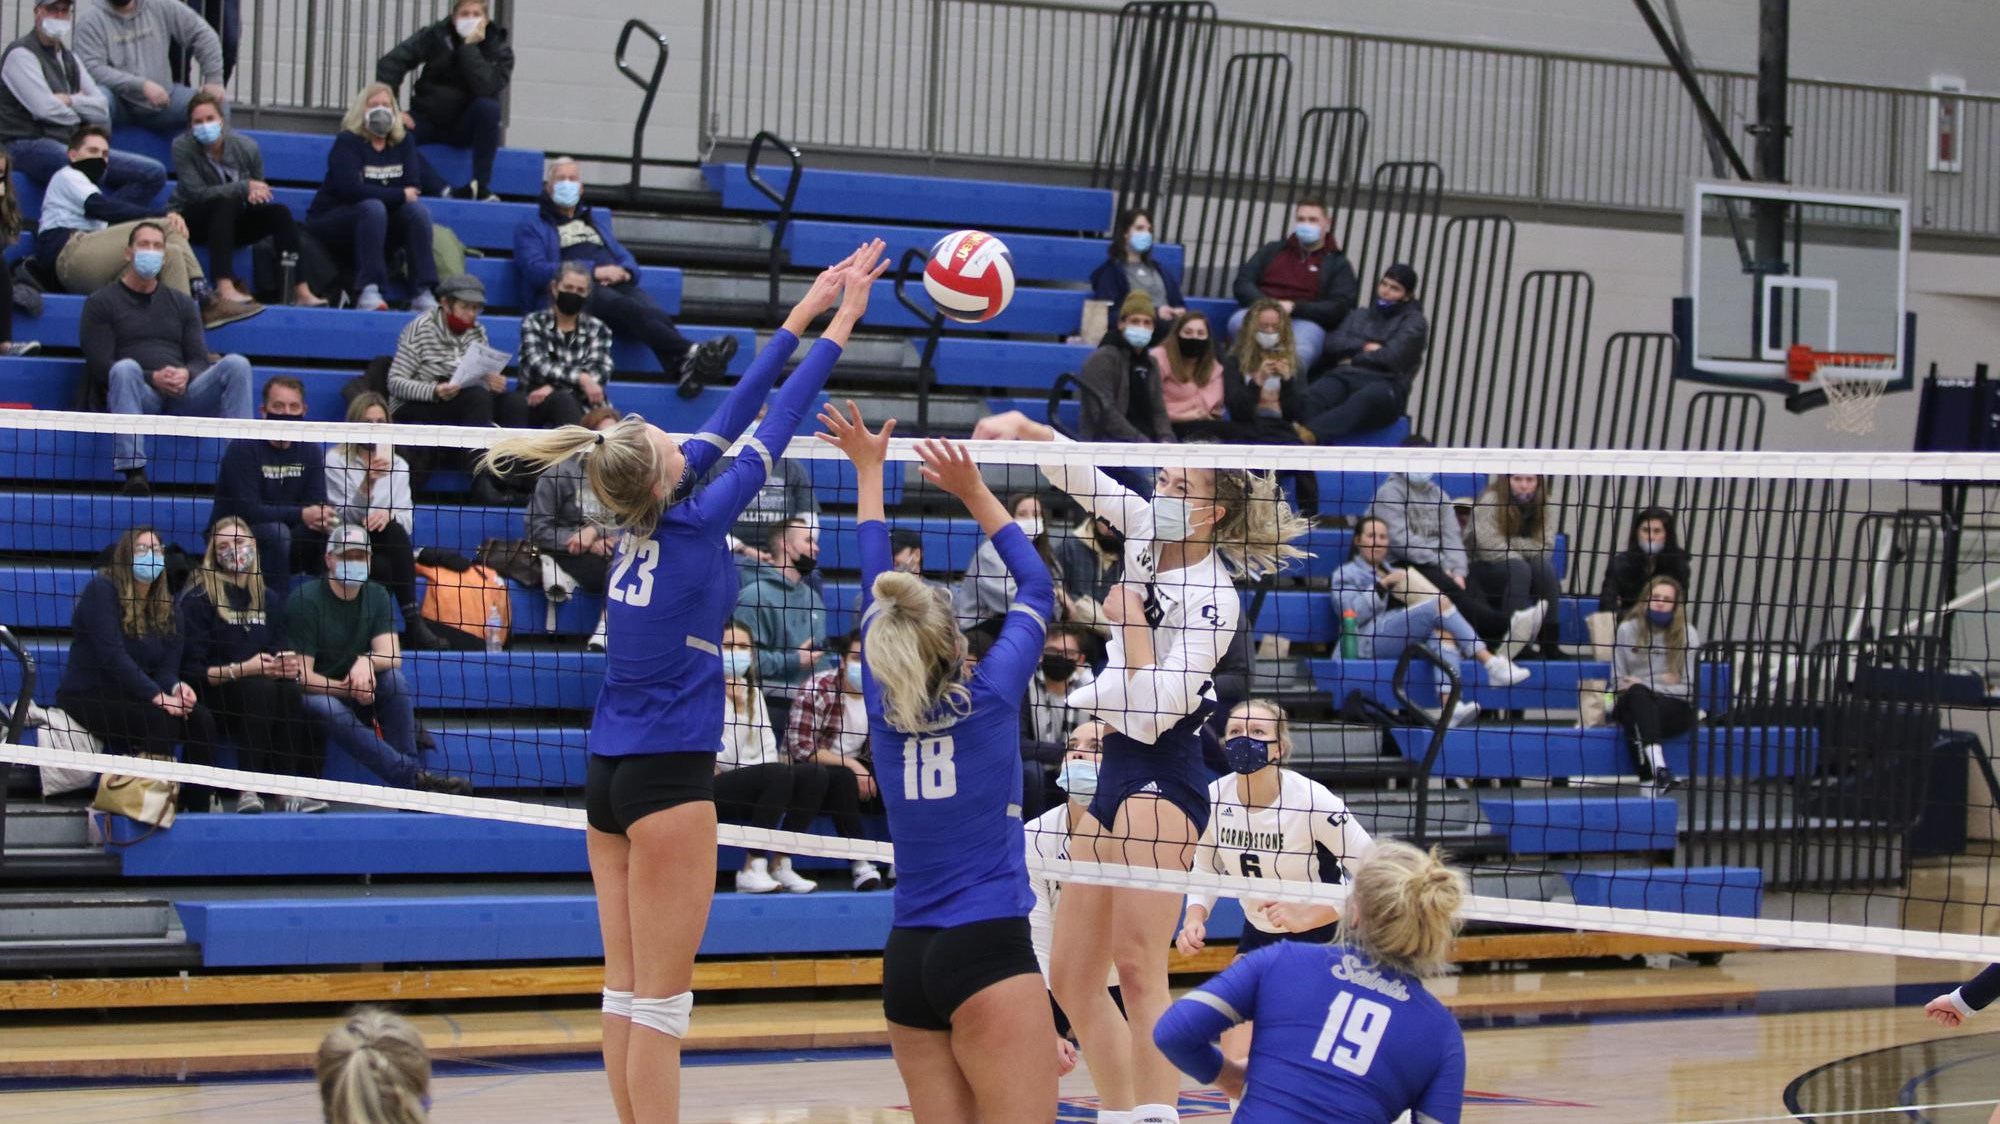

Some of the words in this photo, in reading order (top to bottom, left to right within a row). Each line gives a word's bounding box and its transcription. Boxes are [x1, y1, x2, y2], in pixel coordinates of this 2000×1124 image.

[608, 532, 660, 607] 23
[903, 735, 957, 800] 18
[1220, 827, 1284, 850] CORNERSTONE
[1331, 954, 1410, 1002] Saints
[1312, 990, 1392, 1077] 19
